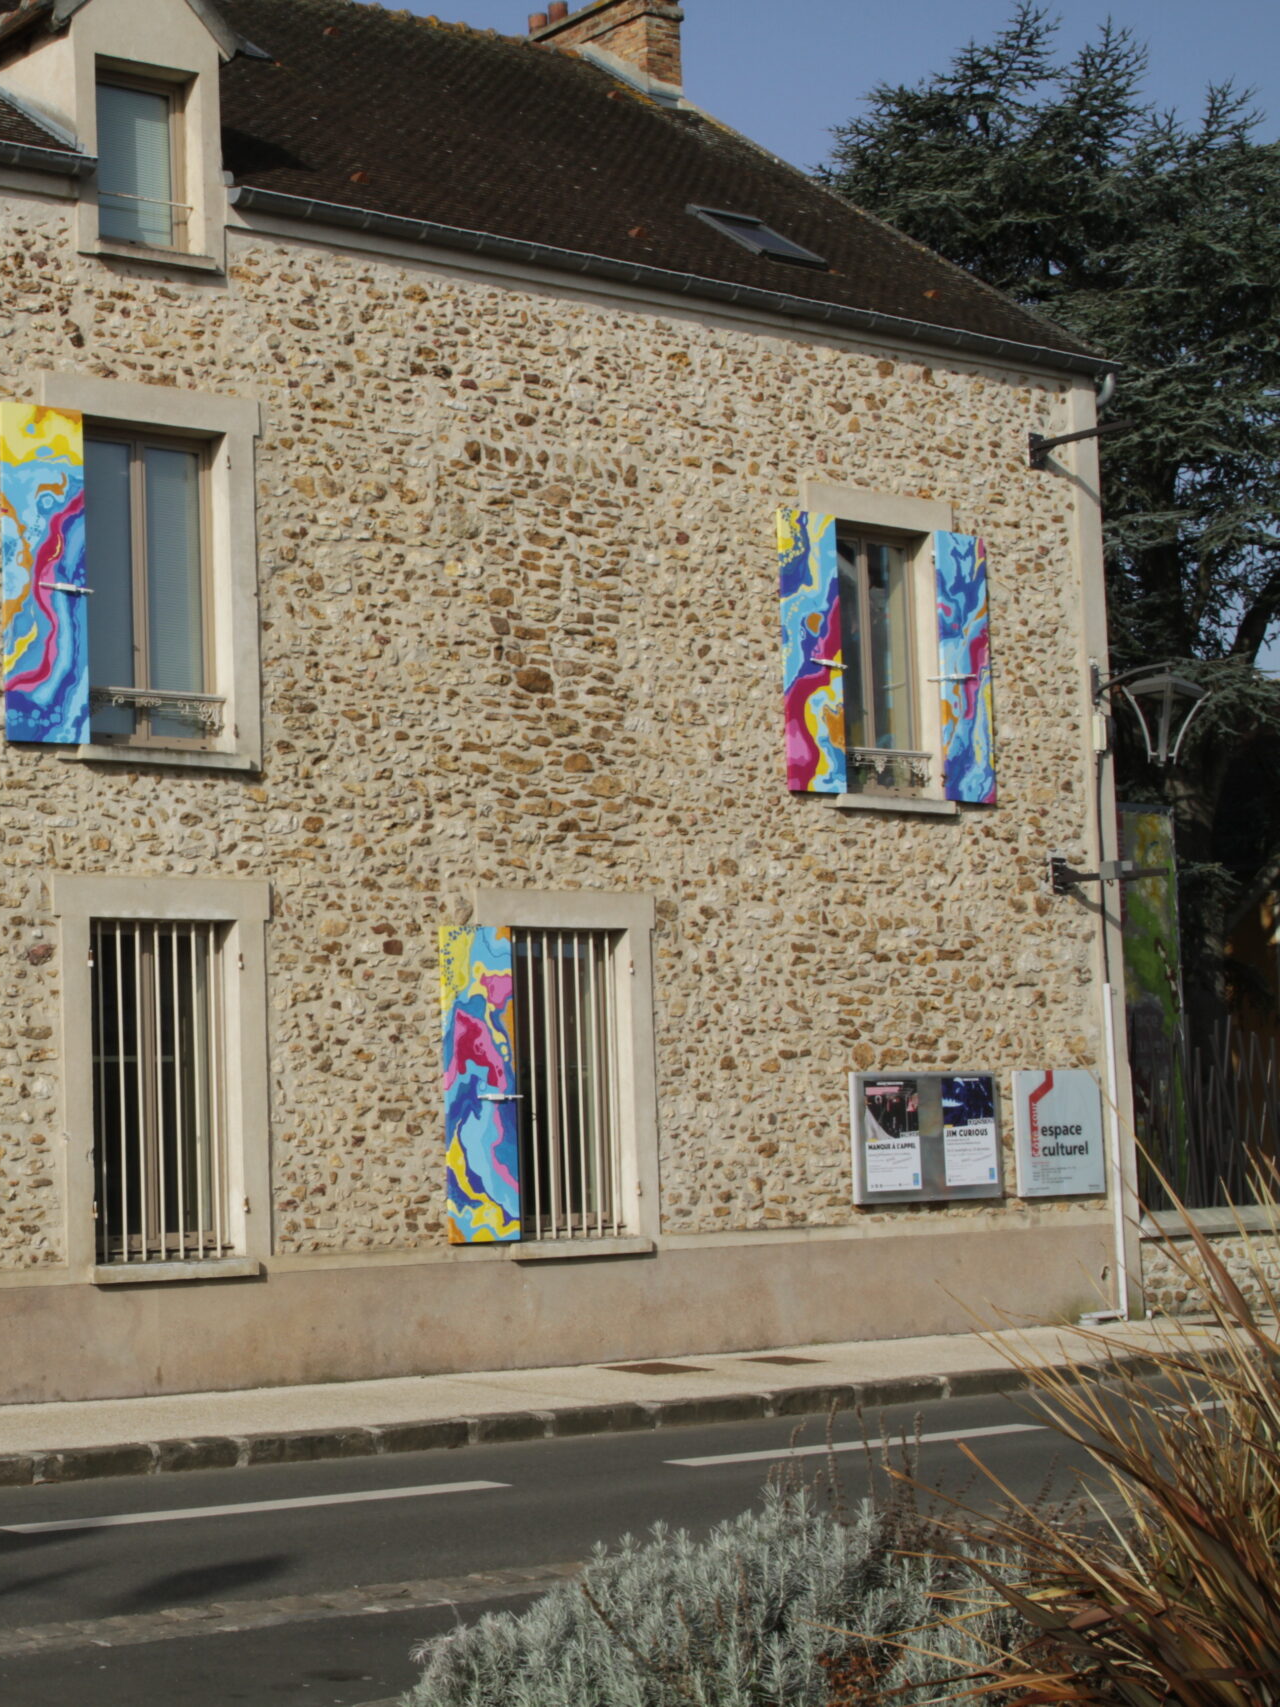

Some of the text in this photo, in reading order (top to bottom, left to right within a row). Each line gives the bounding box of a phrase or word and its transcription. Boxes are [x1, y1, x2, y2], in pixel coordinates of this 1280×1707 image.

[946, 1128, 988, 1138] JIM CURIOUS
[1040, 1124, 1082, 1140] espace
[1042, 1140, 1089, 1157] culturel
